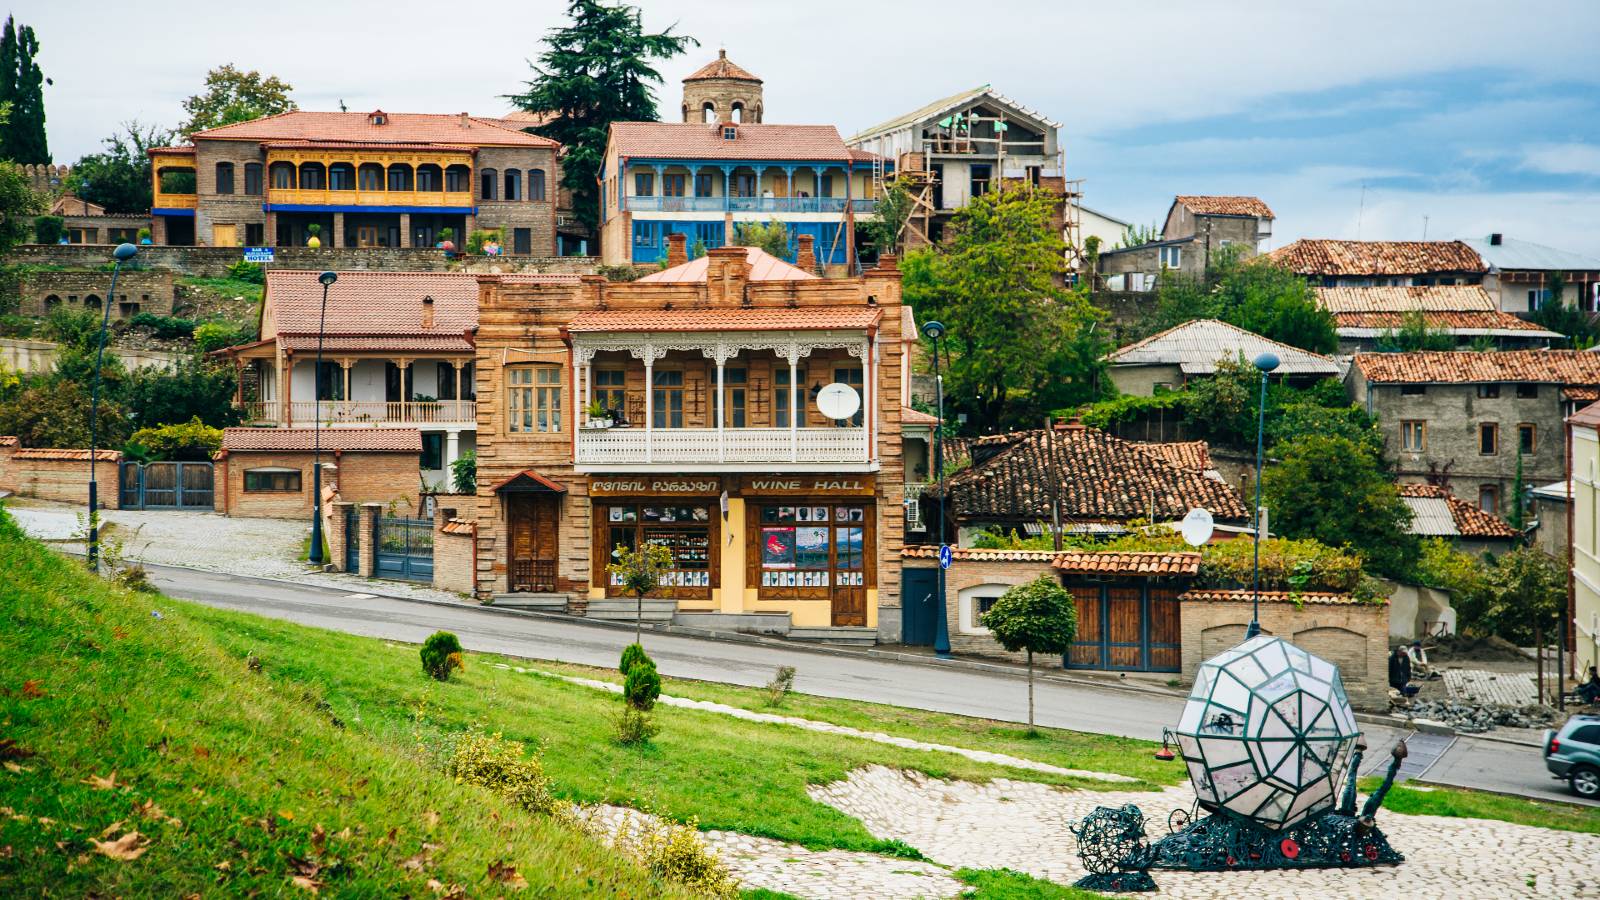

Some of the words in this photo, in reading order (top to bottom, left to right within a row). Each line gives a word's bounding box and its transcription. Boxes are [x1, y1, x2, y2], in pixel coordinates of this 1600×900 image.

[592, 481, 646, 492] ღვინის
[652, 481, 717, 492] დარბაზი
[752, 481, 802, 490] WINE
[814, 481, 864, 490] HALL
